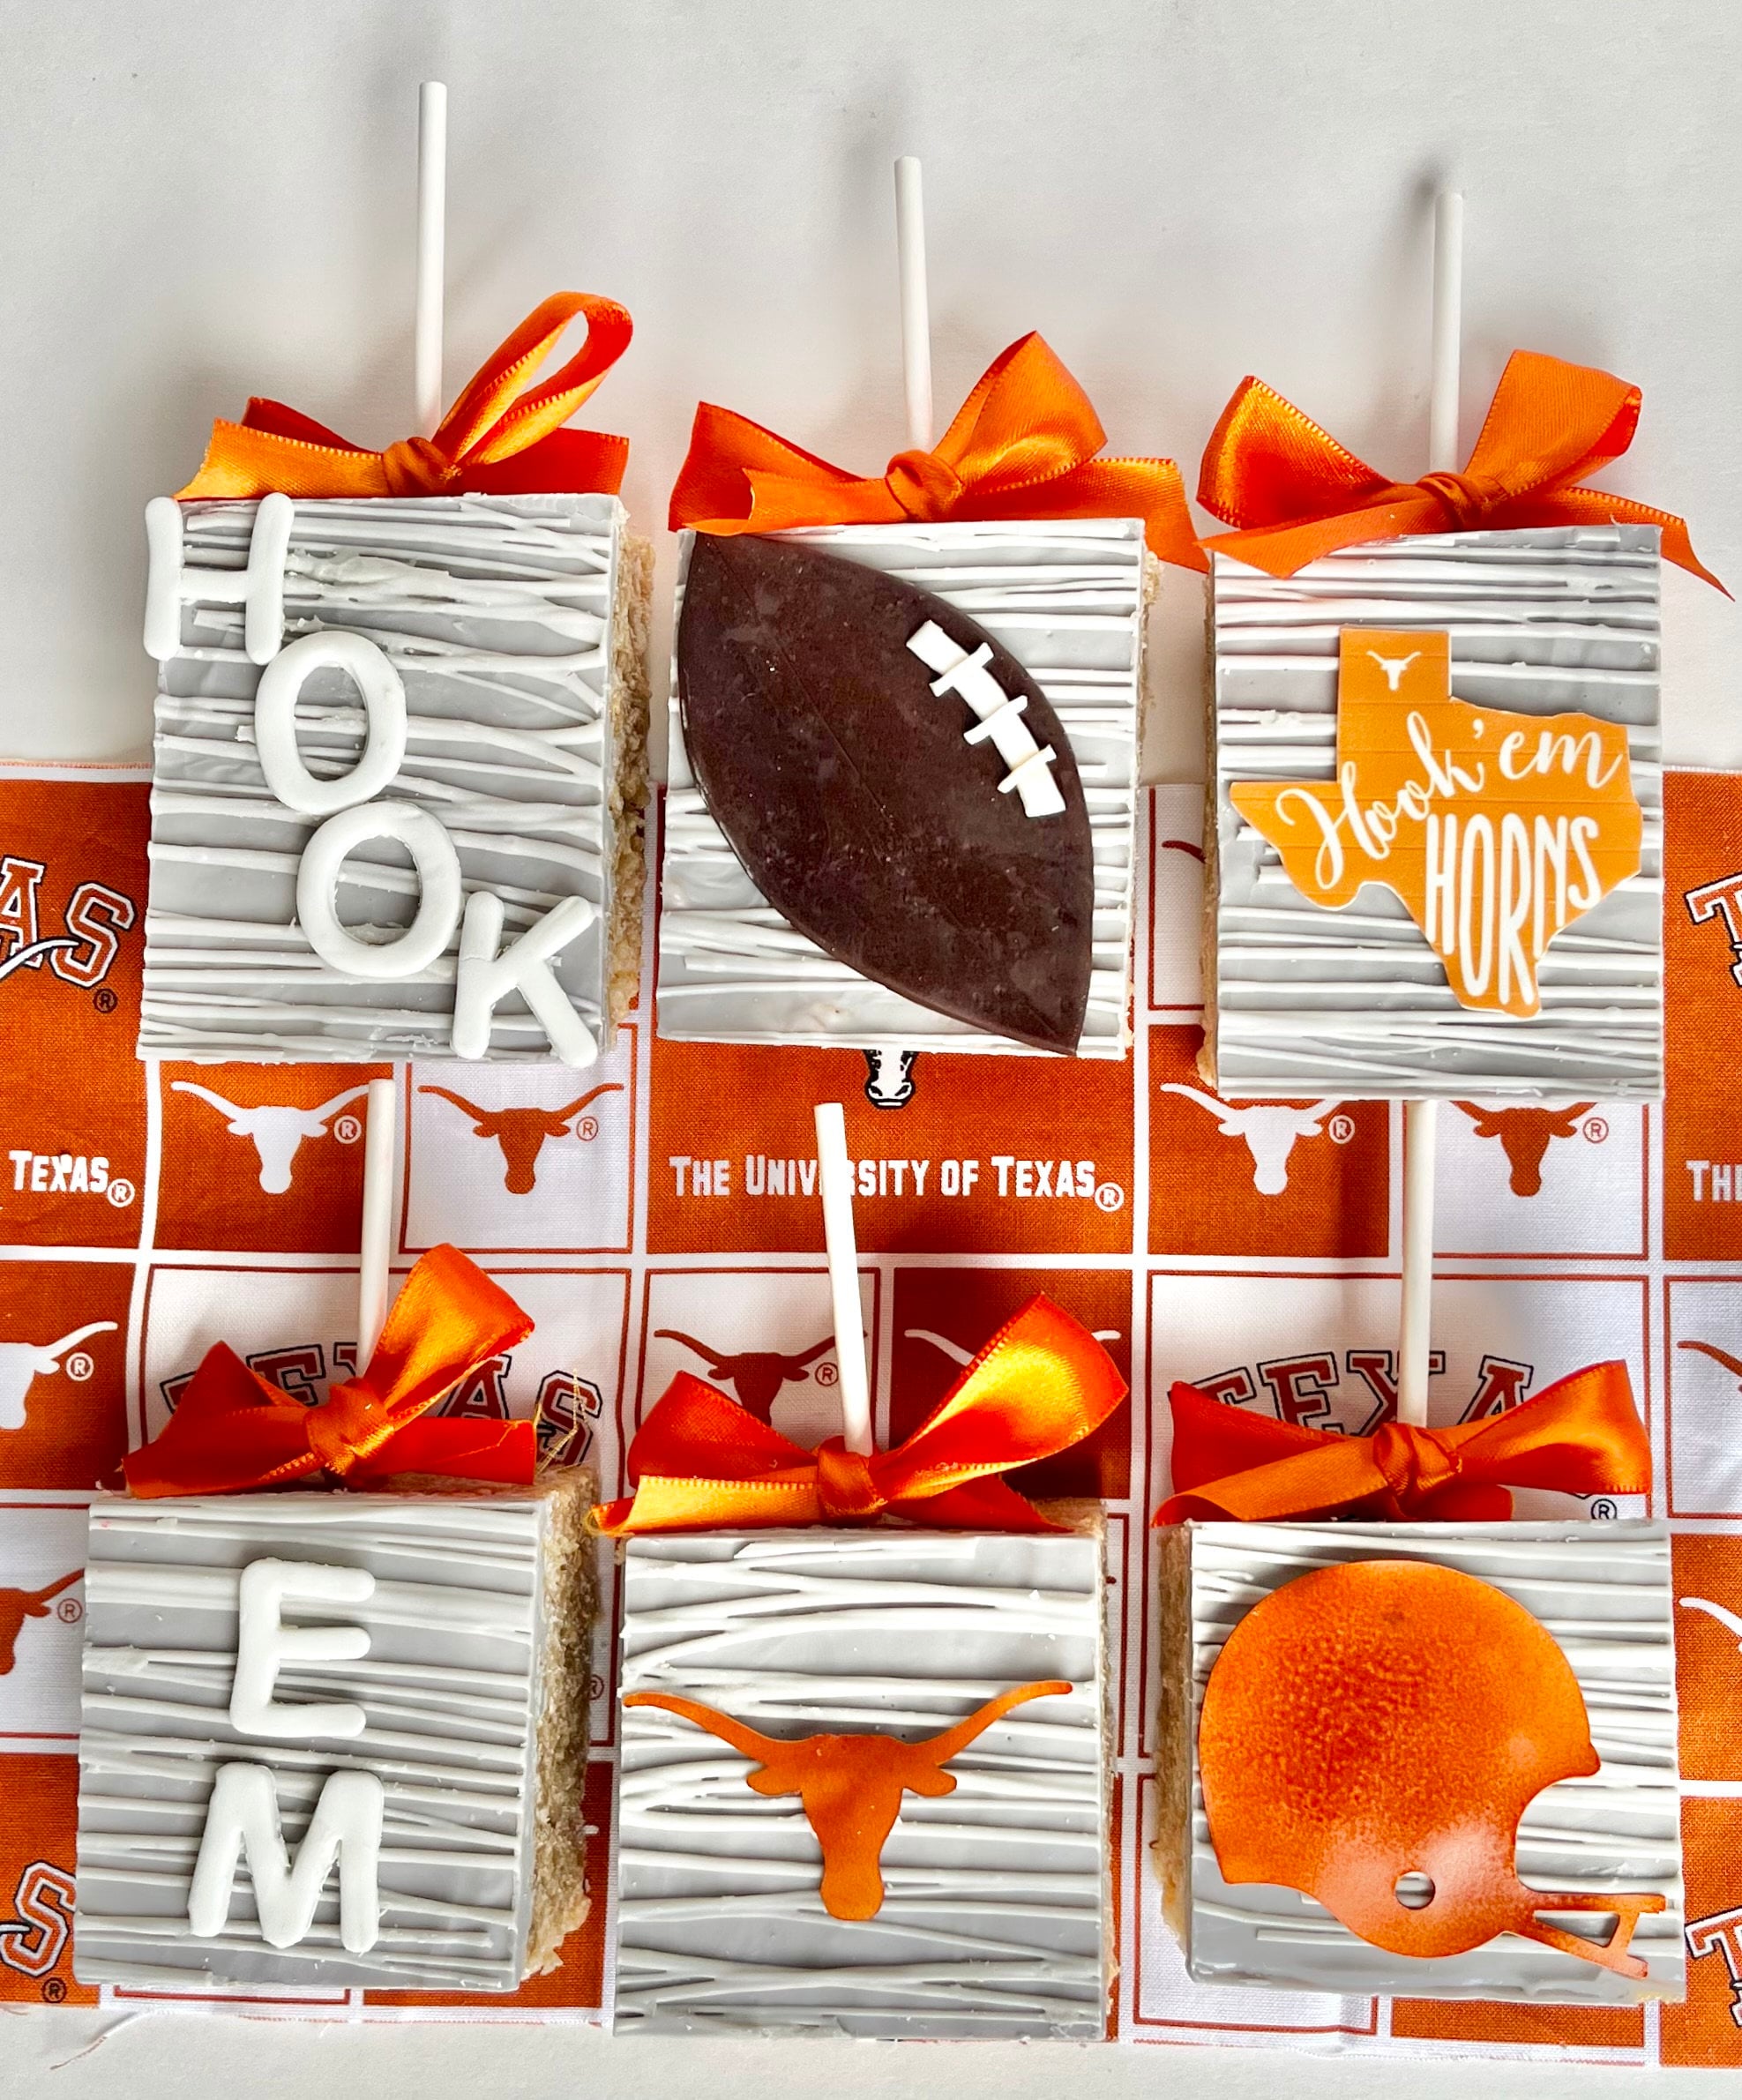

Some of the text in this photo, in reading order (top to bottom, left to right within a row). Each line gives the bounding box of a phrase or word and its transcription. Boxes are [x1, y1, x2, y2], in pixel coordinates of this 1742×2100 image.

[1275, 712, 1484, 889] Hook
[1424, 812, 1603, 1005] HORNS
[9, 1149, 110, 1192] TEXAS
[669, 1155, 1095, 1197] THE UNIVSITY OF TEXAS
